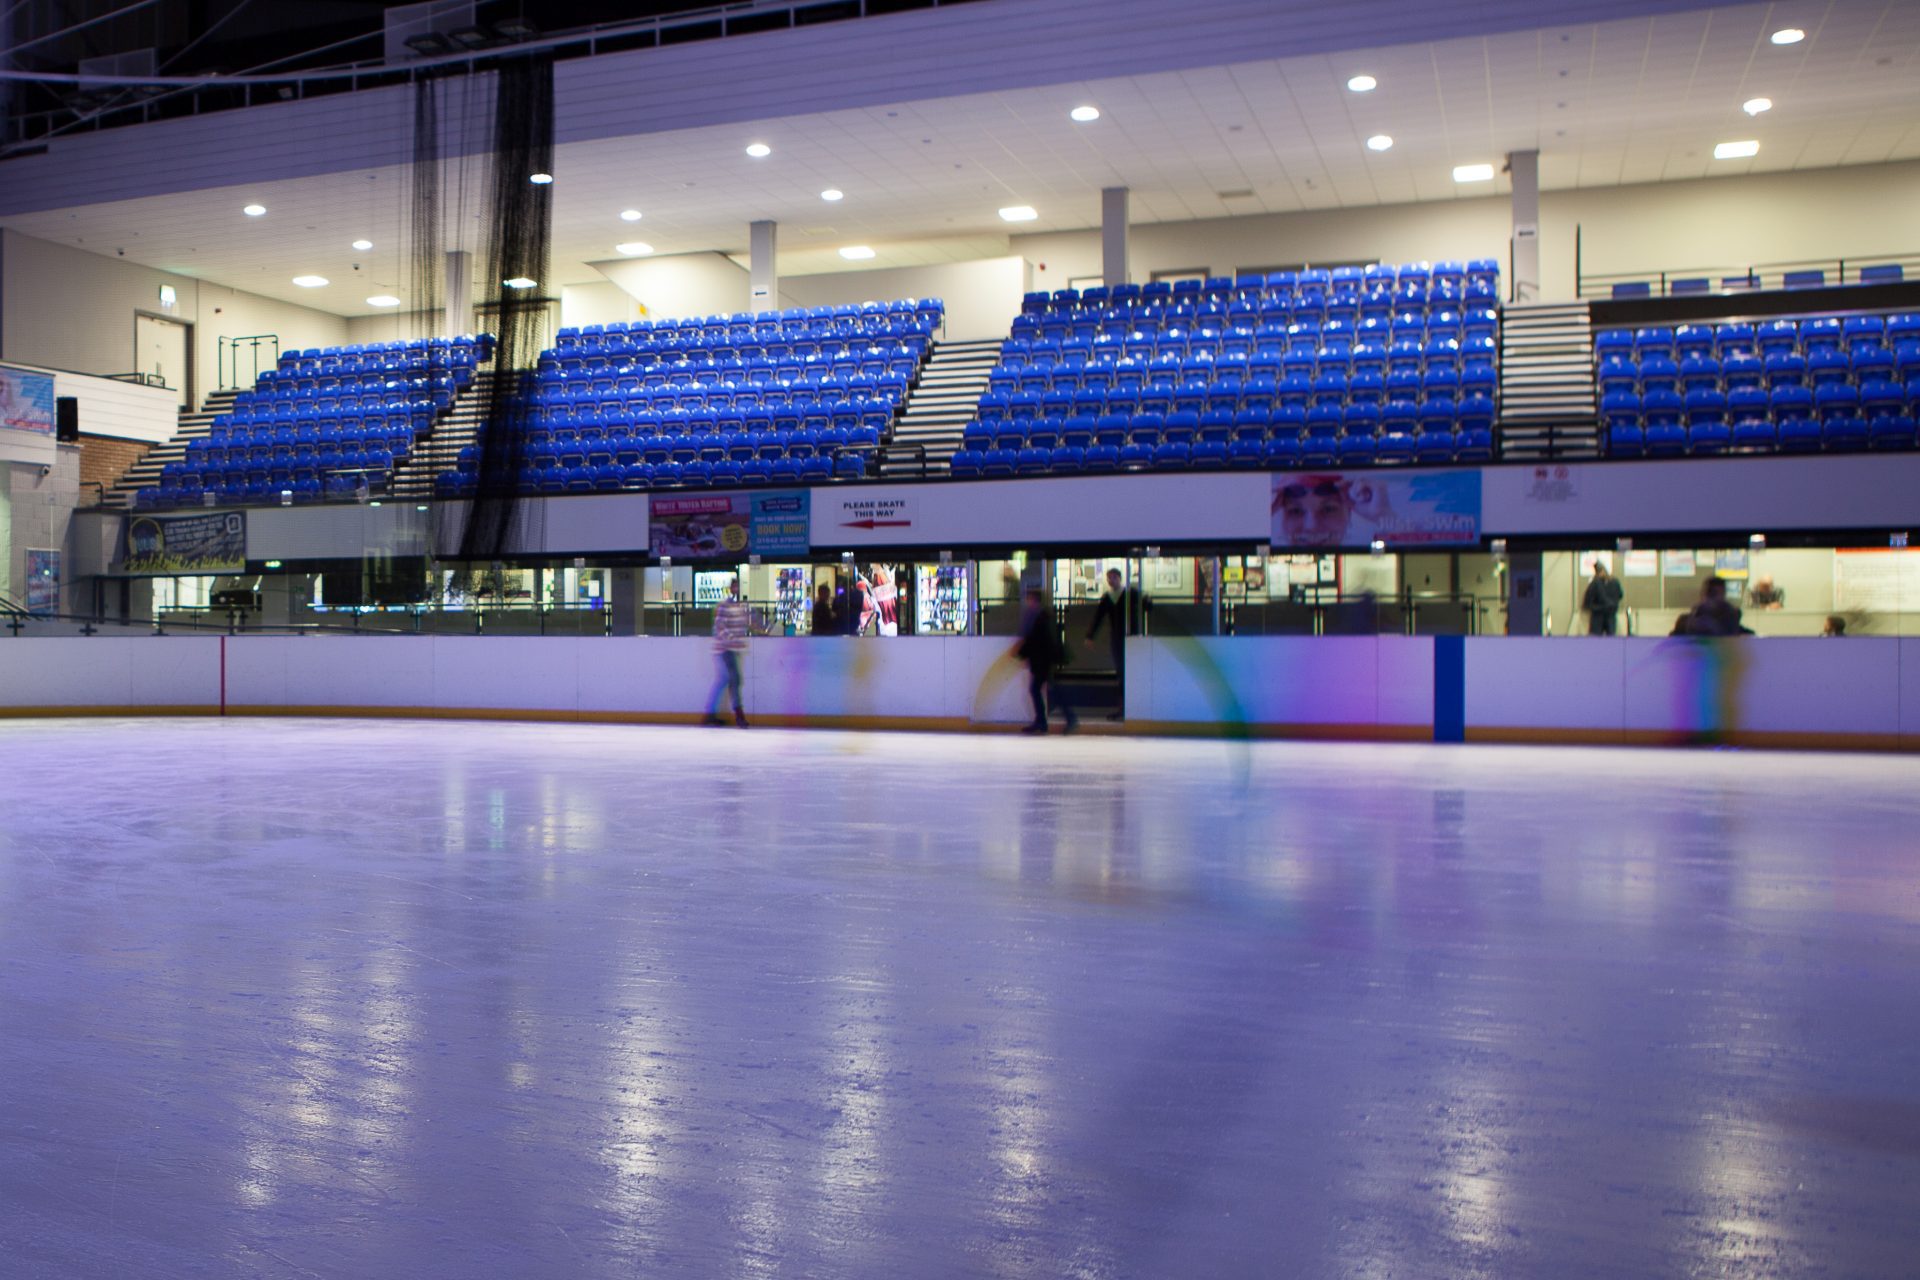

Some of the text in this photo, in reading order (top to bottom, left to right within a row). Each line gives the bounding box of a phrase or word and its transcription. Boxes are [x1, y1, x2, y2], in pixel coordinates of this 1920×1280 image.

[843, 500, 906, 509] PLEASE SKATE
[854, 509, 895, 518] THIS WAY
[756, 524, 780, 535] BOOK
